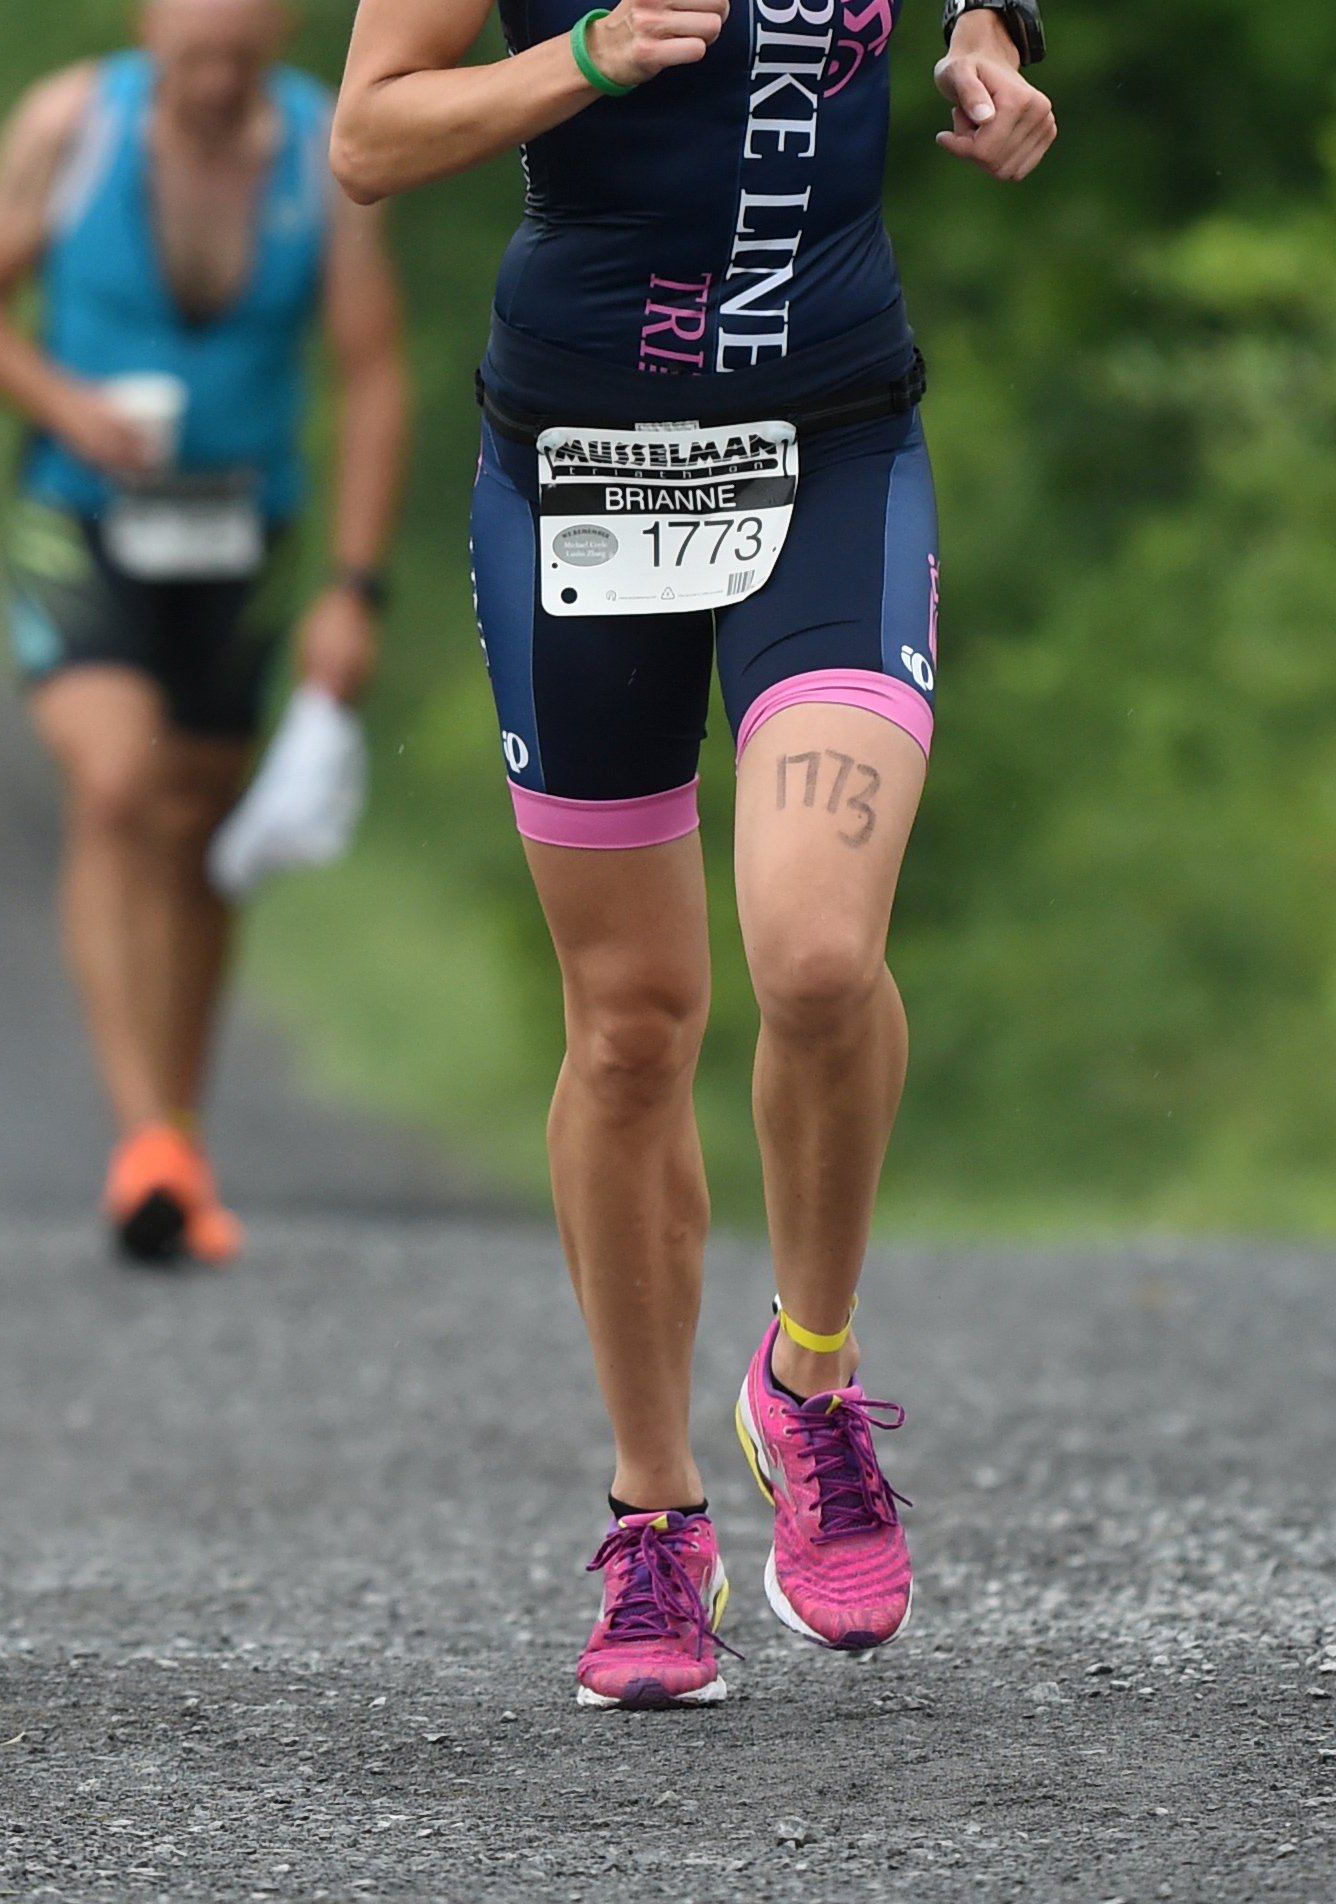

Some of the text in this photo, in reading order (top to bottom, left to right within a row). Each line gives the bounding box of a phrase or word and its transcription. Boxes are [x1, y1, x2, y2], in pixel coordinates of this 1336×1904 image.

[716, 185, 812, 373] LINE
[554, 434, 777, 467] MUSSELMAN
[569, 460, 764, 480] triathlon
[605, 484, 737, 511] BRIANNE
[642, 516, 763, 568] 1773
[776, 748, 882, 849] 1773
